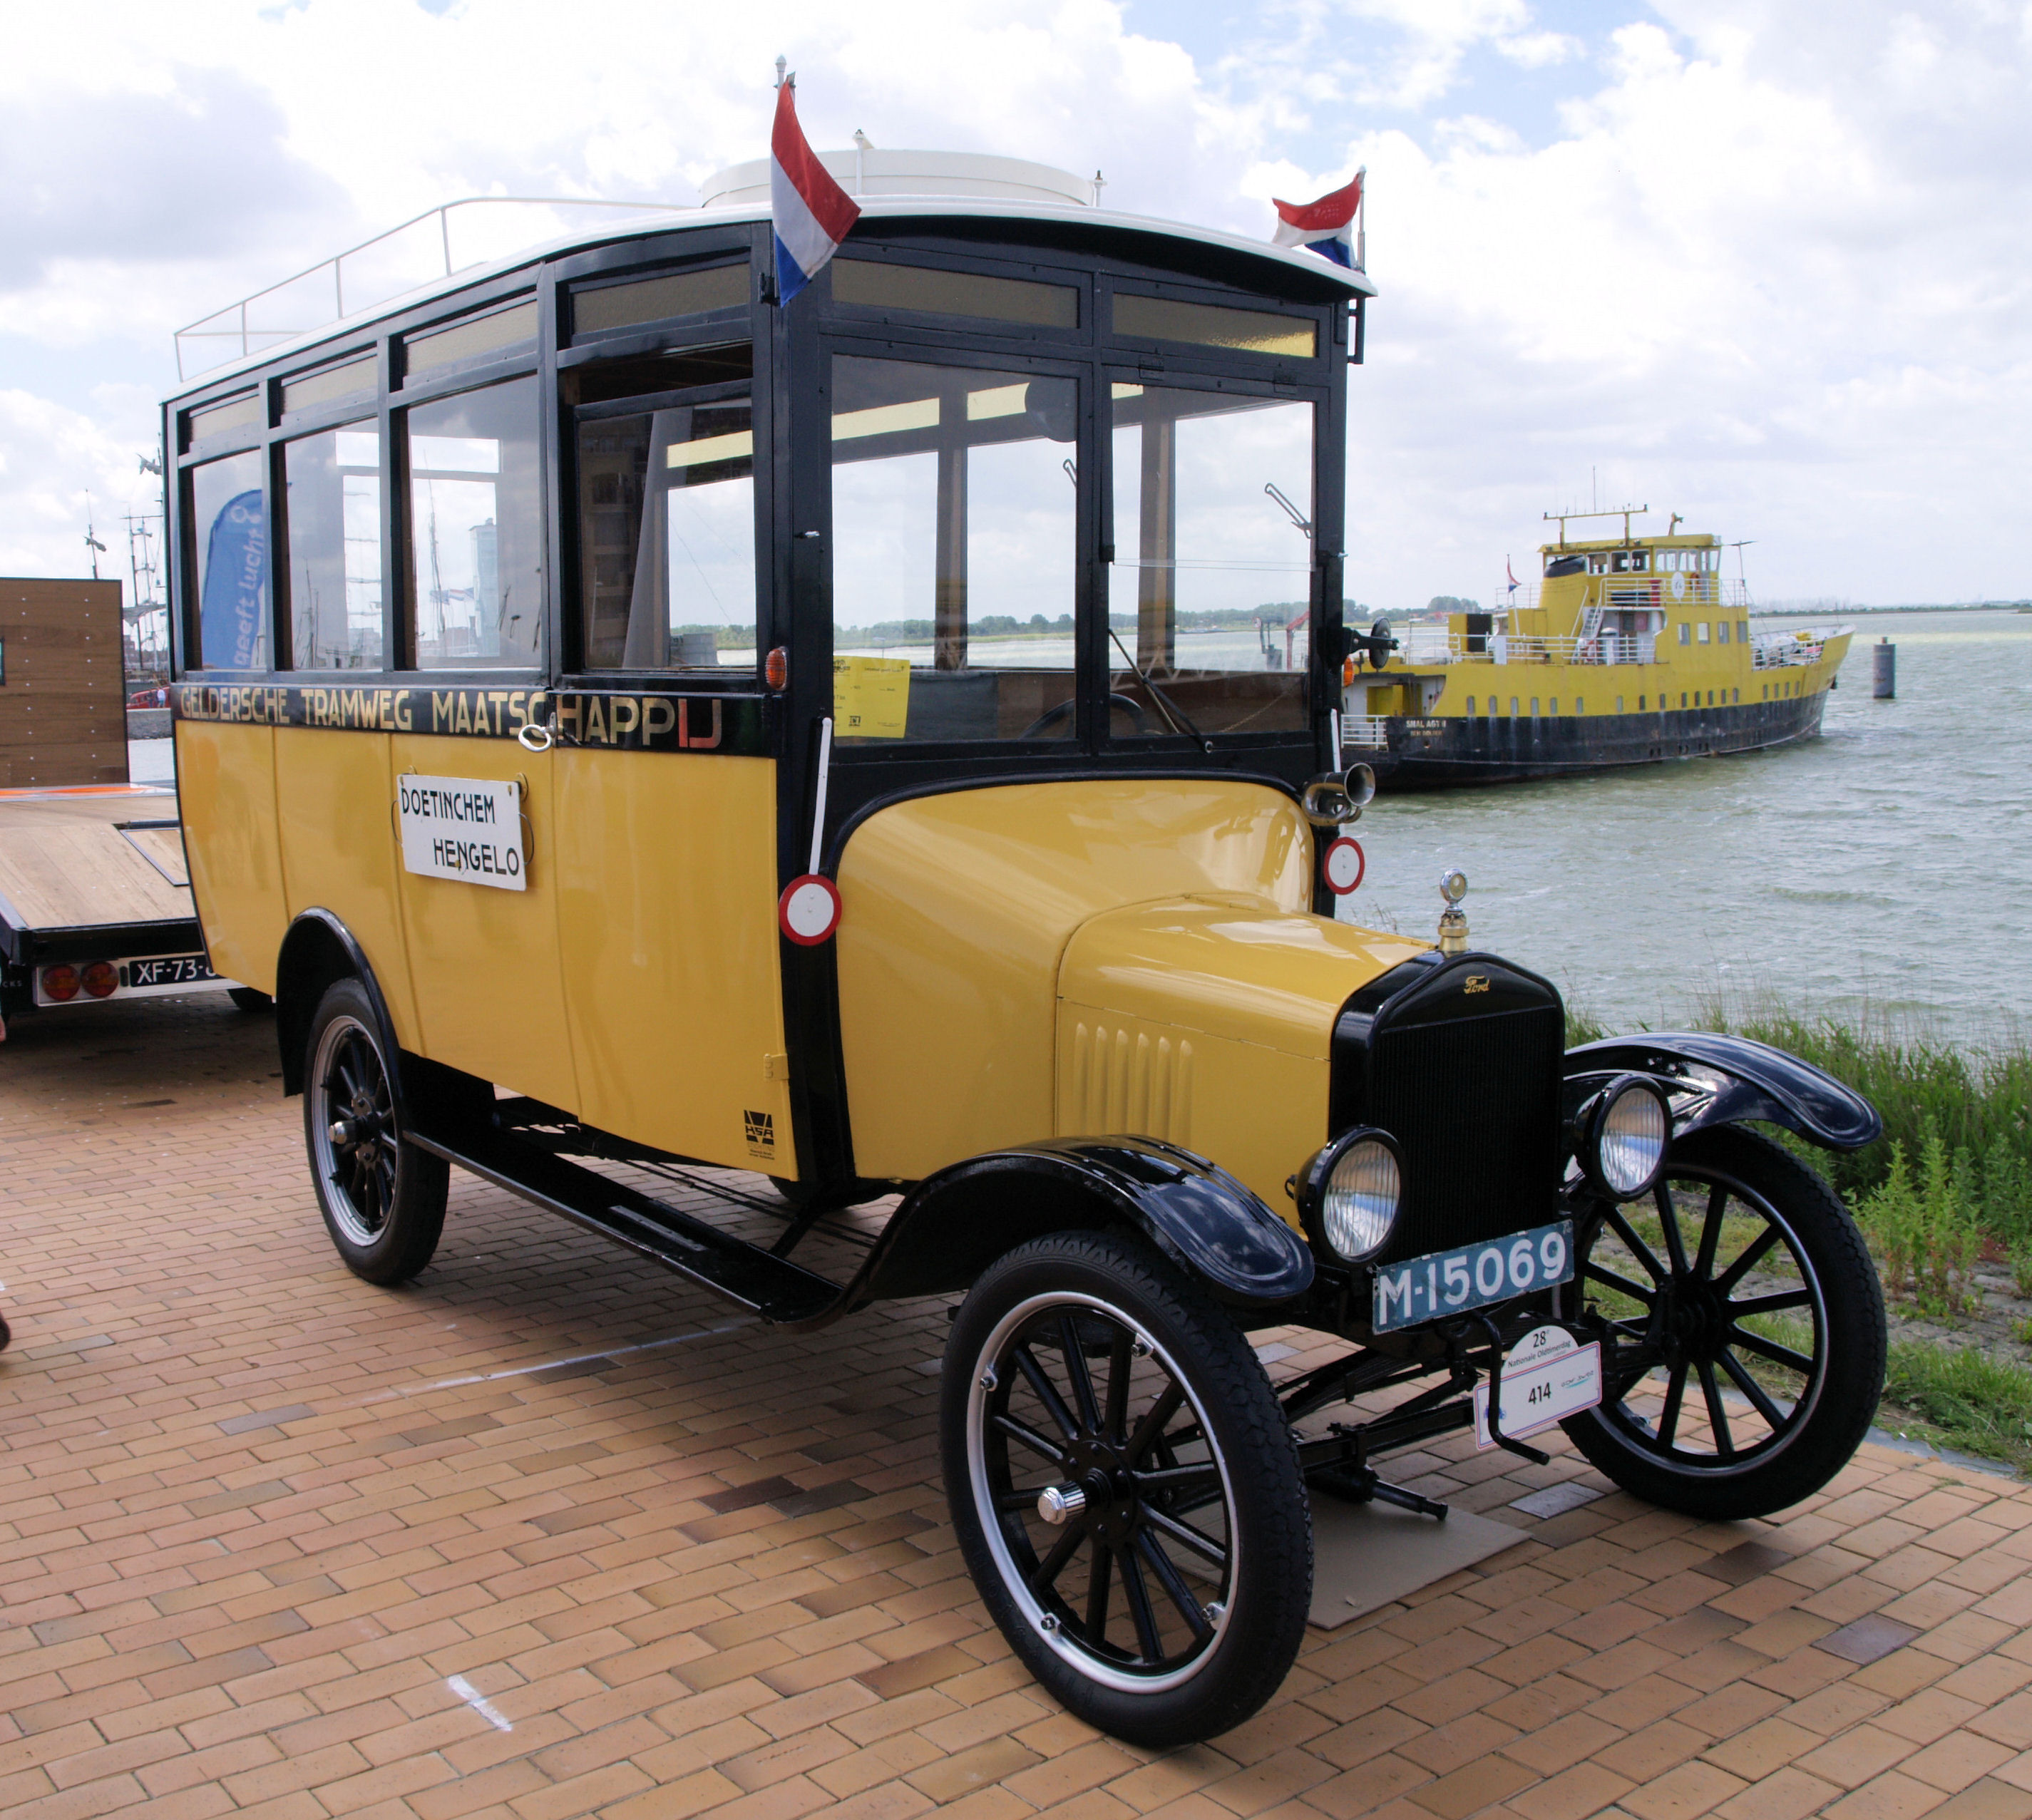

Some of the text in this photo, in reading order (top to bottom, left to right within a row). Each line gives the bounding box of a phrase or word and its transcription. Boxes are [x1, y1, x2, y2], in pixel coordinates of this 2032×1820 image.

[180, 687, 722, 749] GELDERSCHE TRAMWEG MAATSCHAPPIJ
[401, 787, 496, 824] DOETINCHEM
[433, 838, 519, 876] HENGELO
[1464, 975, 1490, 994] Ford
[745, 1125, 774, 1138] HSA
[1378, 1231, 1566, 1326] M-15069
[1507, 1352, 1536, 1368] Nationale
[1529, 1382, 1551, 1404] 414
